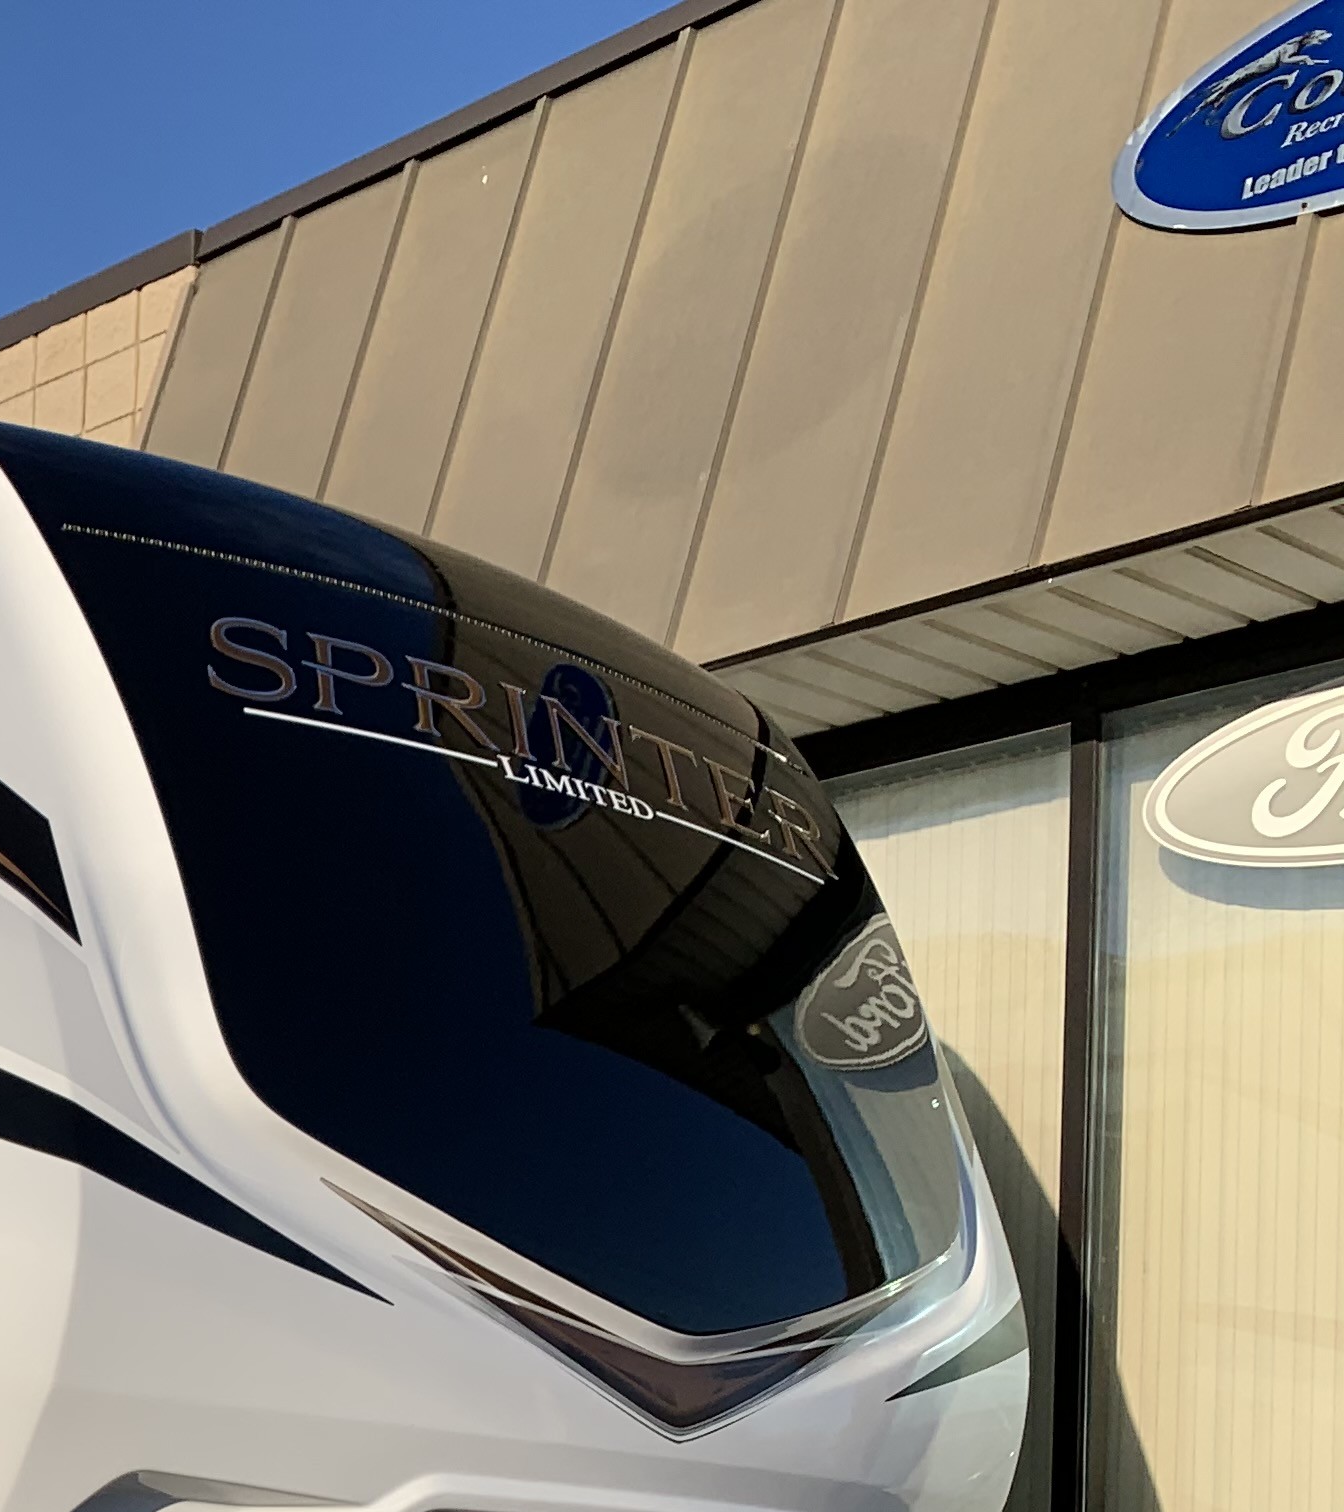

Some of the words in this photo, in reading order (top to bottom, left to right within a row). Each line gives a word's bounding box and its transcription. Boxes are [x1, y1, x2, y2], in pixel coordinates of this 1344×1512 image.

[1241, 149, 1333, 200] Leader
[208, 616, 840, 881] SPRINTER
[496, 754, 655, 821] LIMITED
